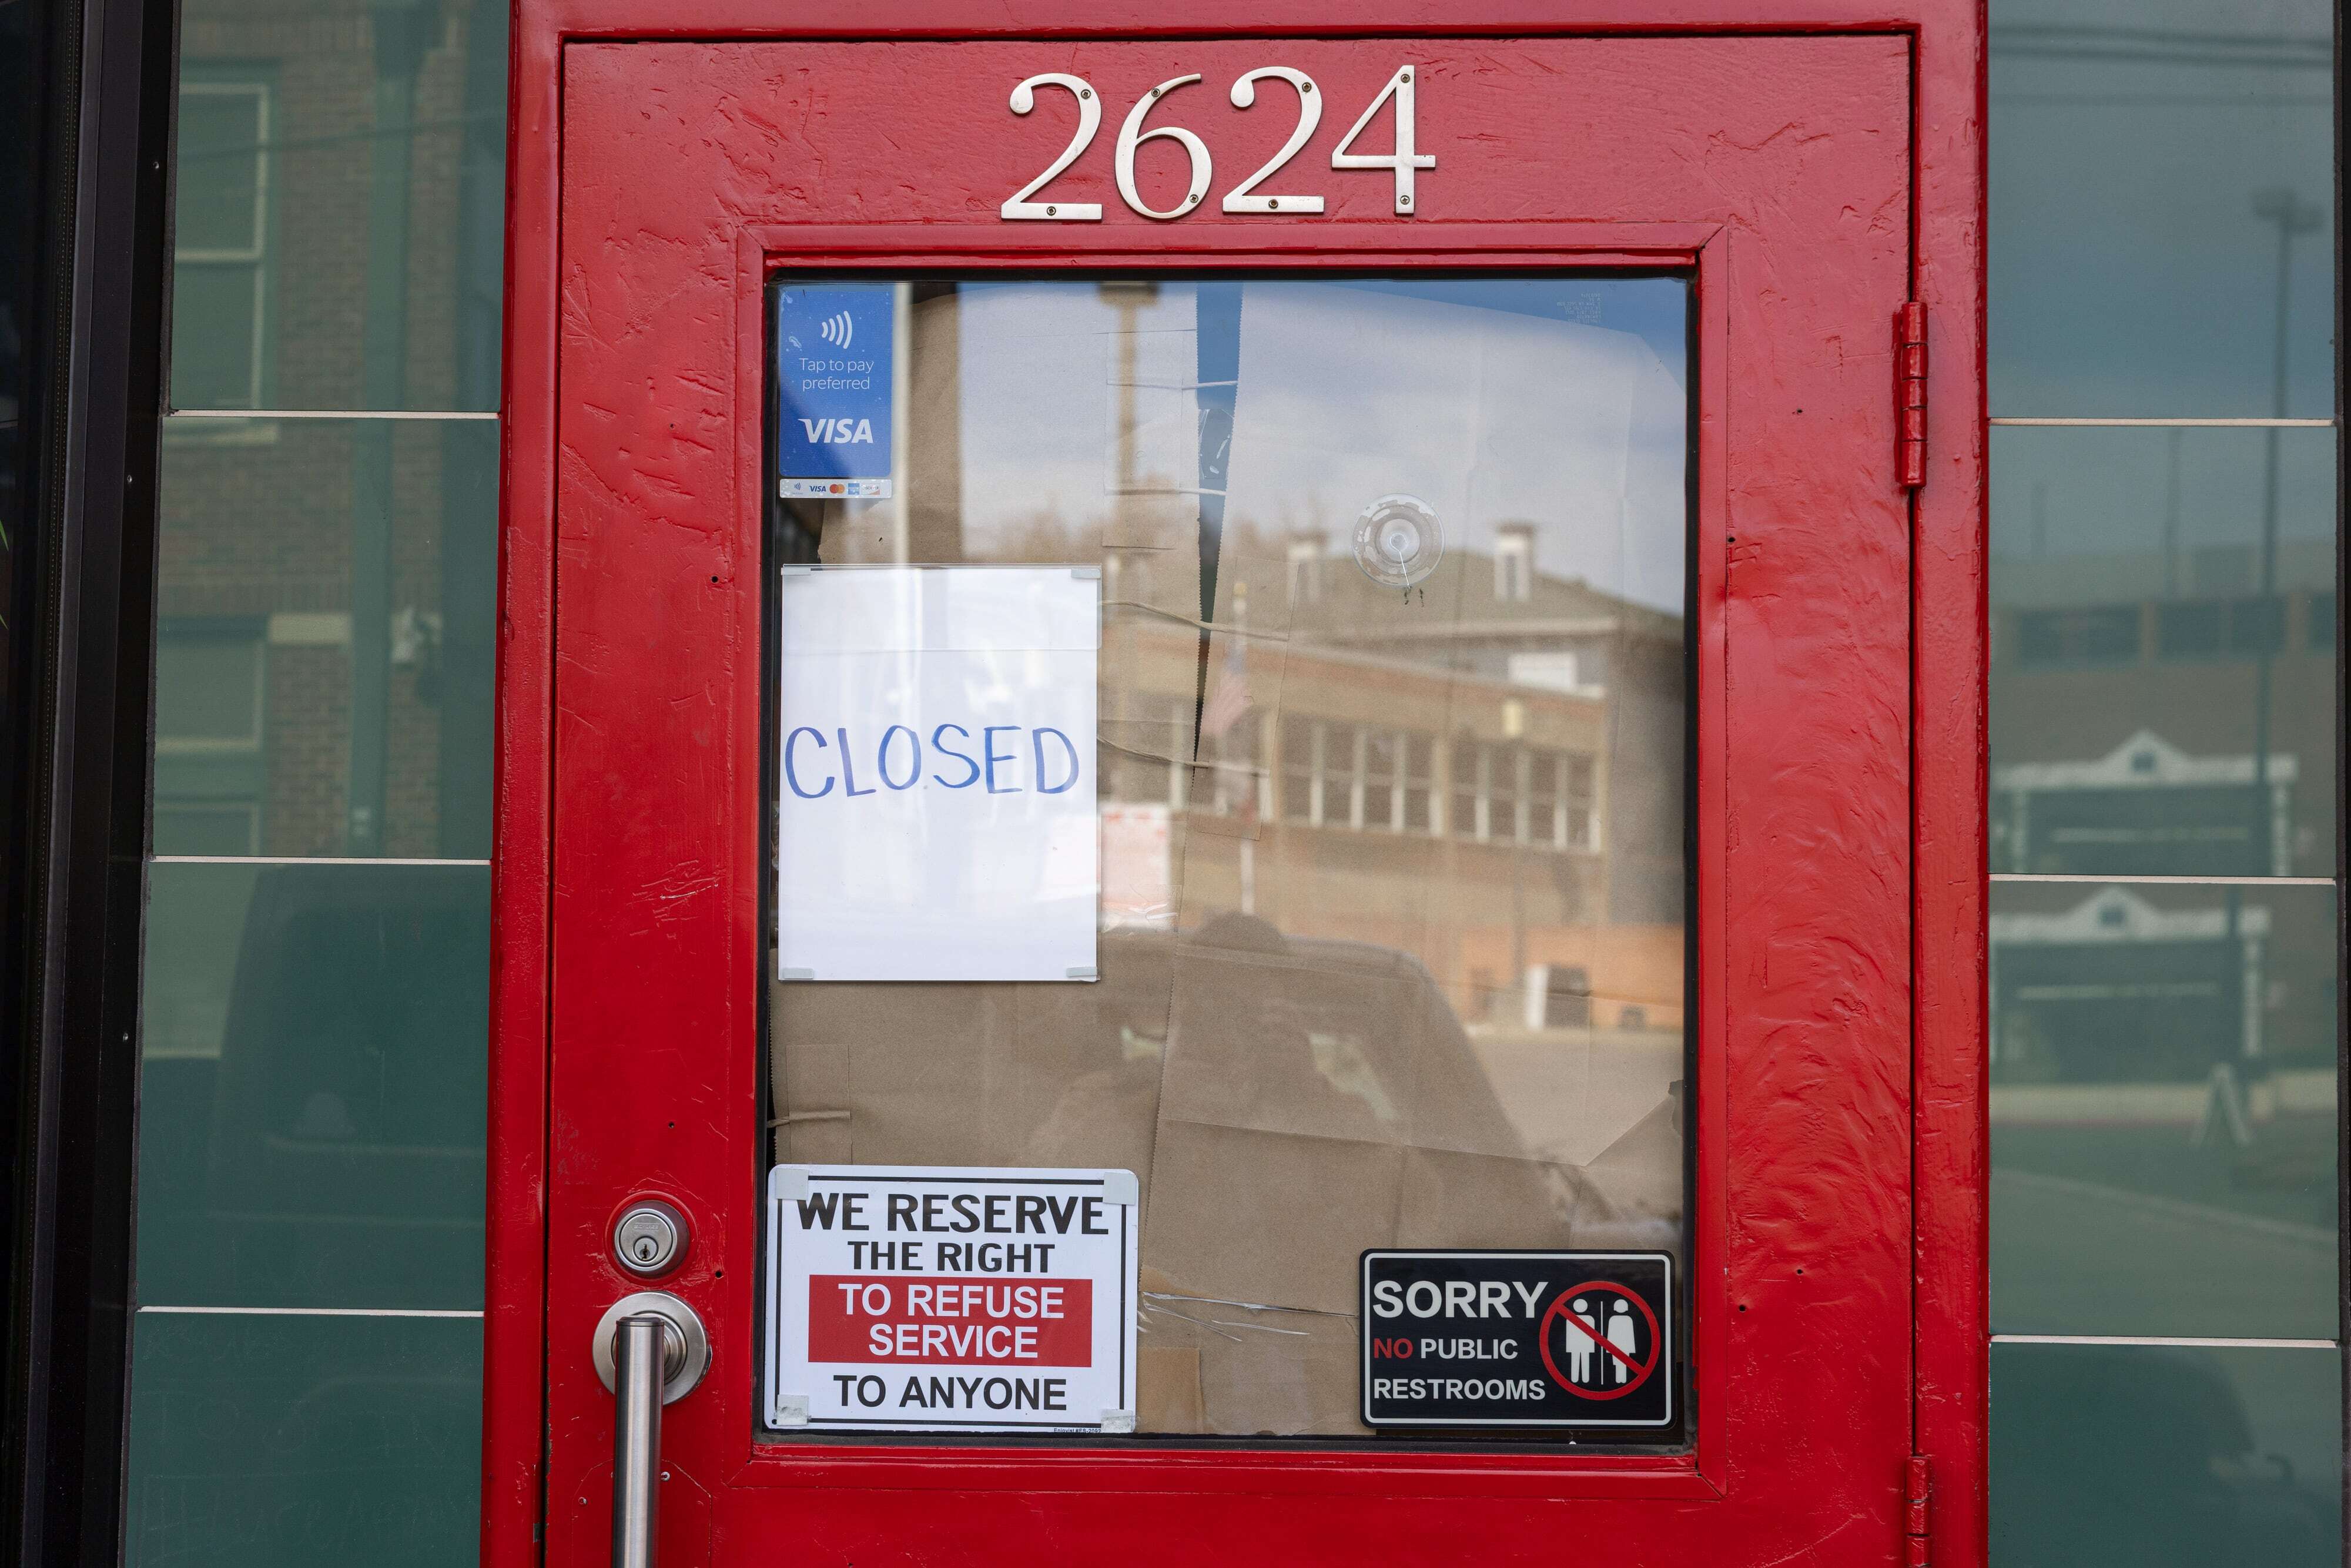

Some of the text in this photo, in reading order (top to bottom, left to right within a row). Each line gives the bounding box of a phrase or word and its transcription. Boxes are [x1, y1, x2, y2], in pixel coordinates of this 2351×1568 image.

[1001, 65, 1436, 220] 2624
[799, 358, 874, 374] Tap to pay
[803, 377, 870, 391] preferred
[798, 418, 873, 443] VISA
[785, 723, 1079, 799] CLOSED
[797, 1192, 1109, 1235] WE RESERVE
[848, 1241, 1055, 1273] THE RIGHT
[838, 1283, 1064, 1319] TO REFUSE
[1372, 1280, 1549, 1318] SORRY
[869, 1324, 1038, 1359] SERVICE
[1374, 1338, 1518, 1359] NO PUBLIC
[833, 1375, 1067, 1410] TO ANYONE
[1374, 1378, 1546, 1400] RESTROOMS
